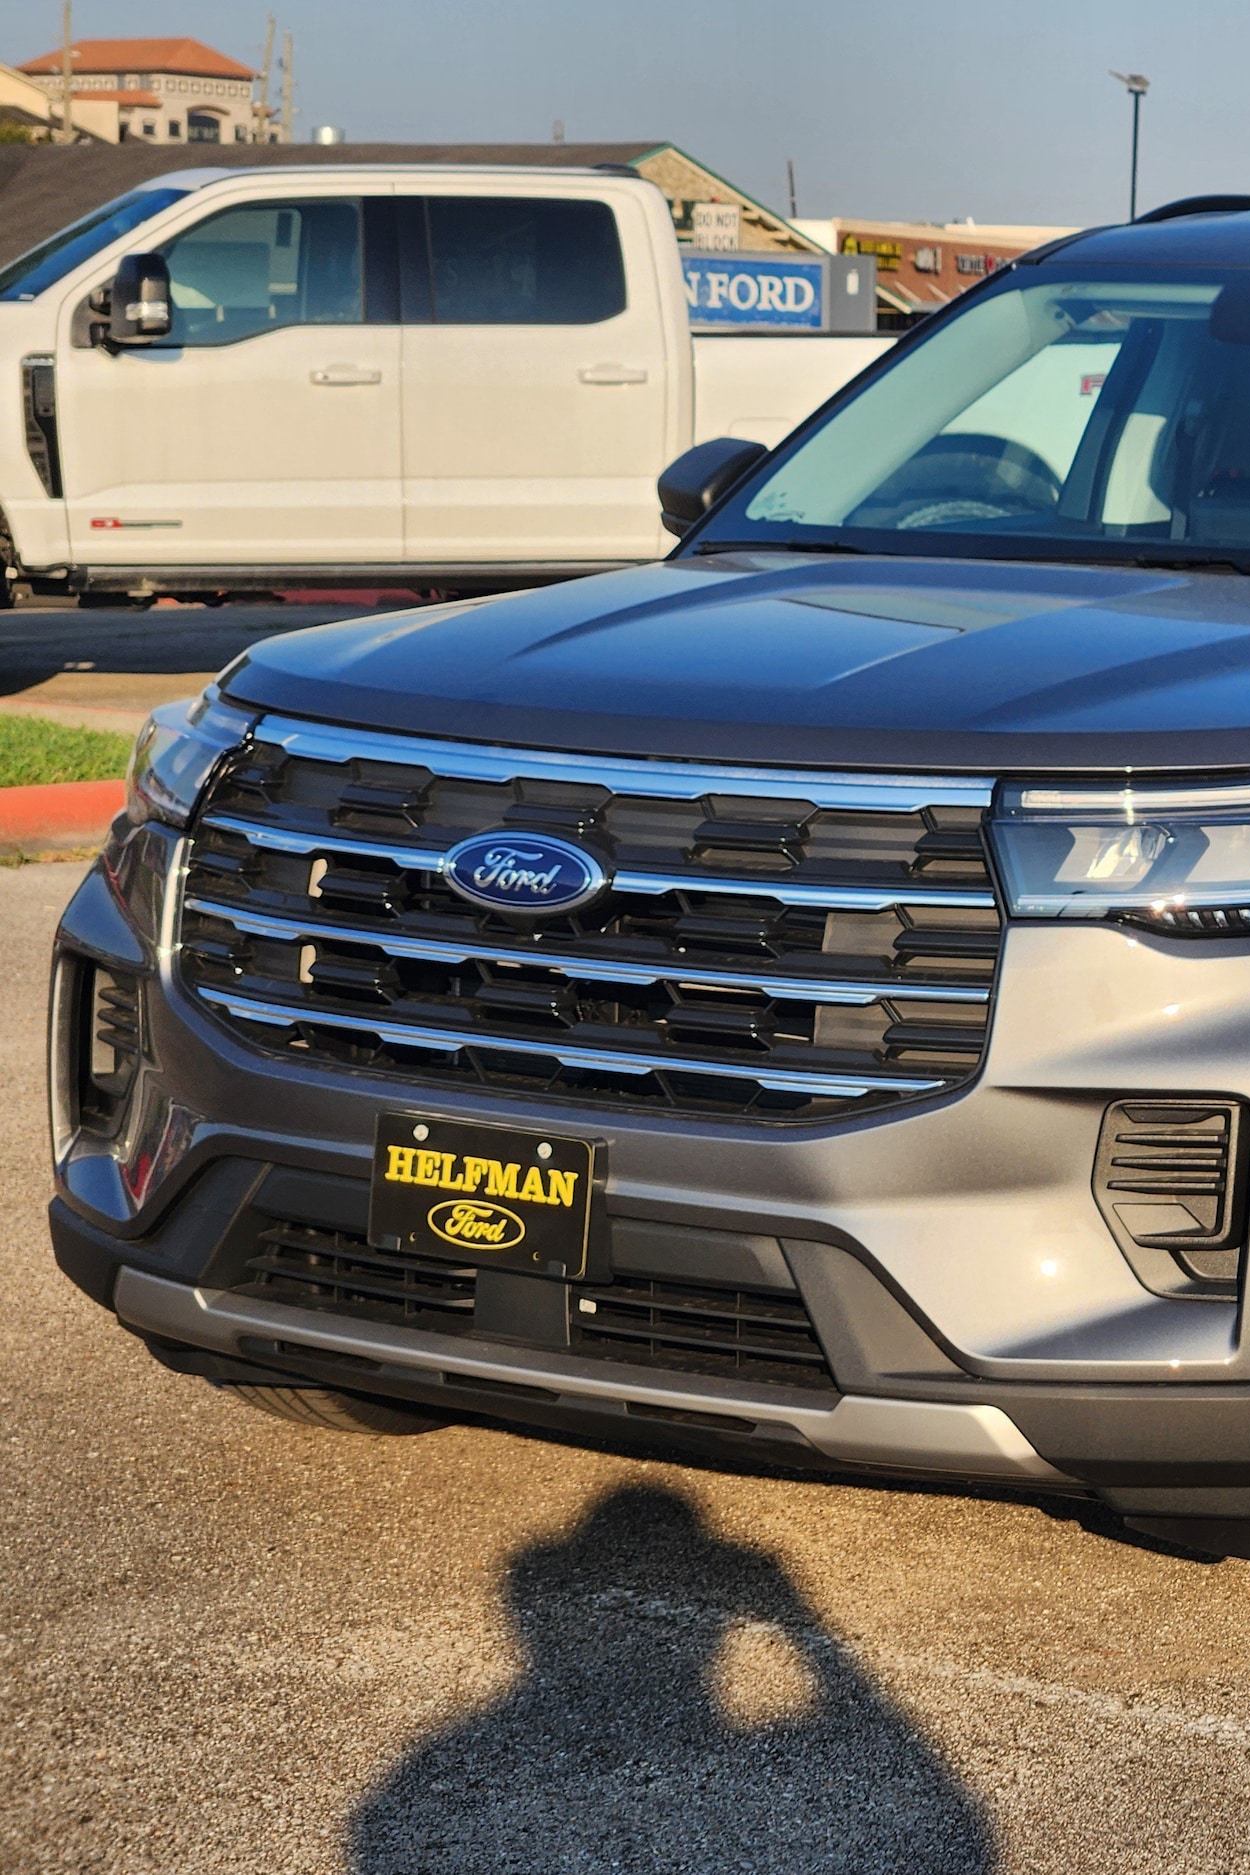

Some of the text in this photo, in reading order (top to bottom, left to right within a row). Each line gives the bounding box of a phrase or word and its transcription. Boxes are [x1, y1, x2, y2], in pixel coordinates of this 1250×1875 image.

[696, 211, 737, 228] DO NOT
[706, 273, 815, 313] FORD
[474, 847, 563, 895] Ford
[384, 1145, 579, 1208] HELFMAN
[445, 1204, 508, 1243] Ford
